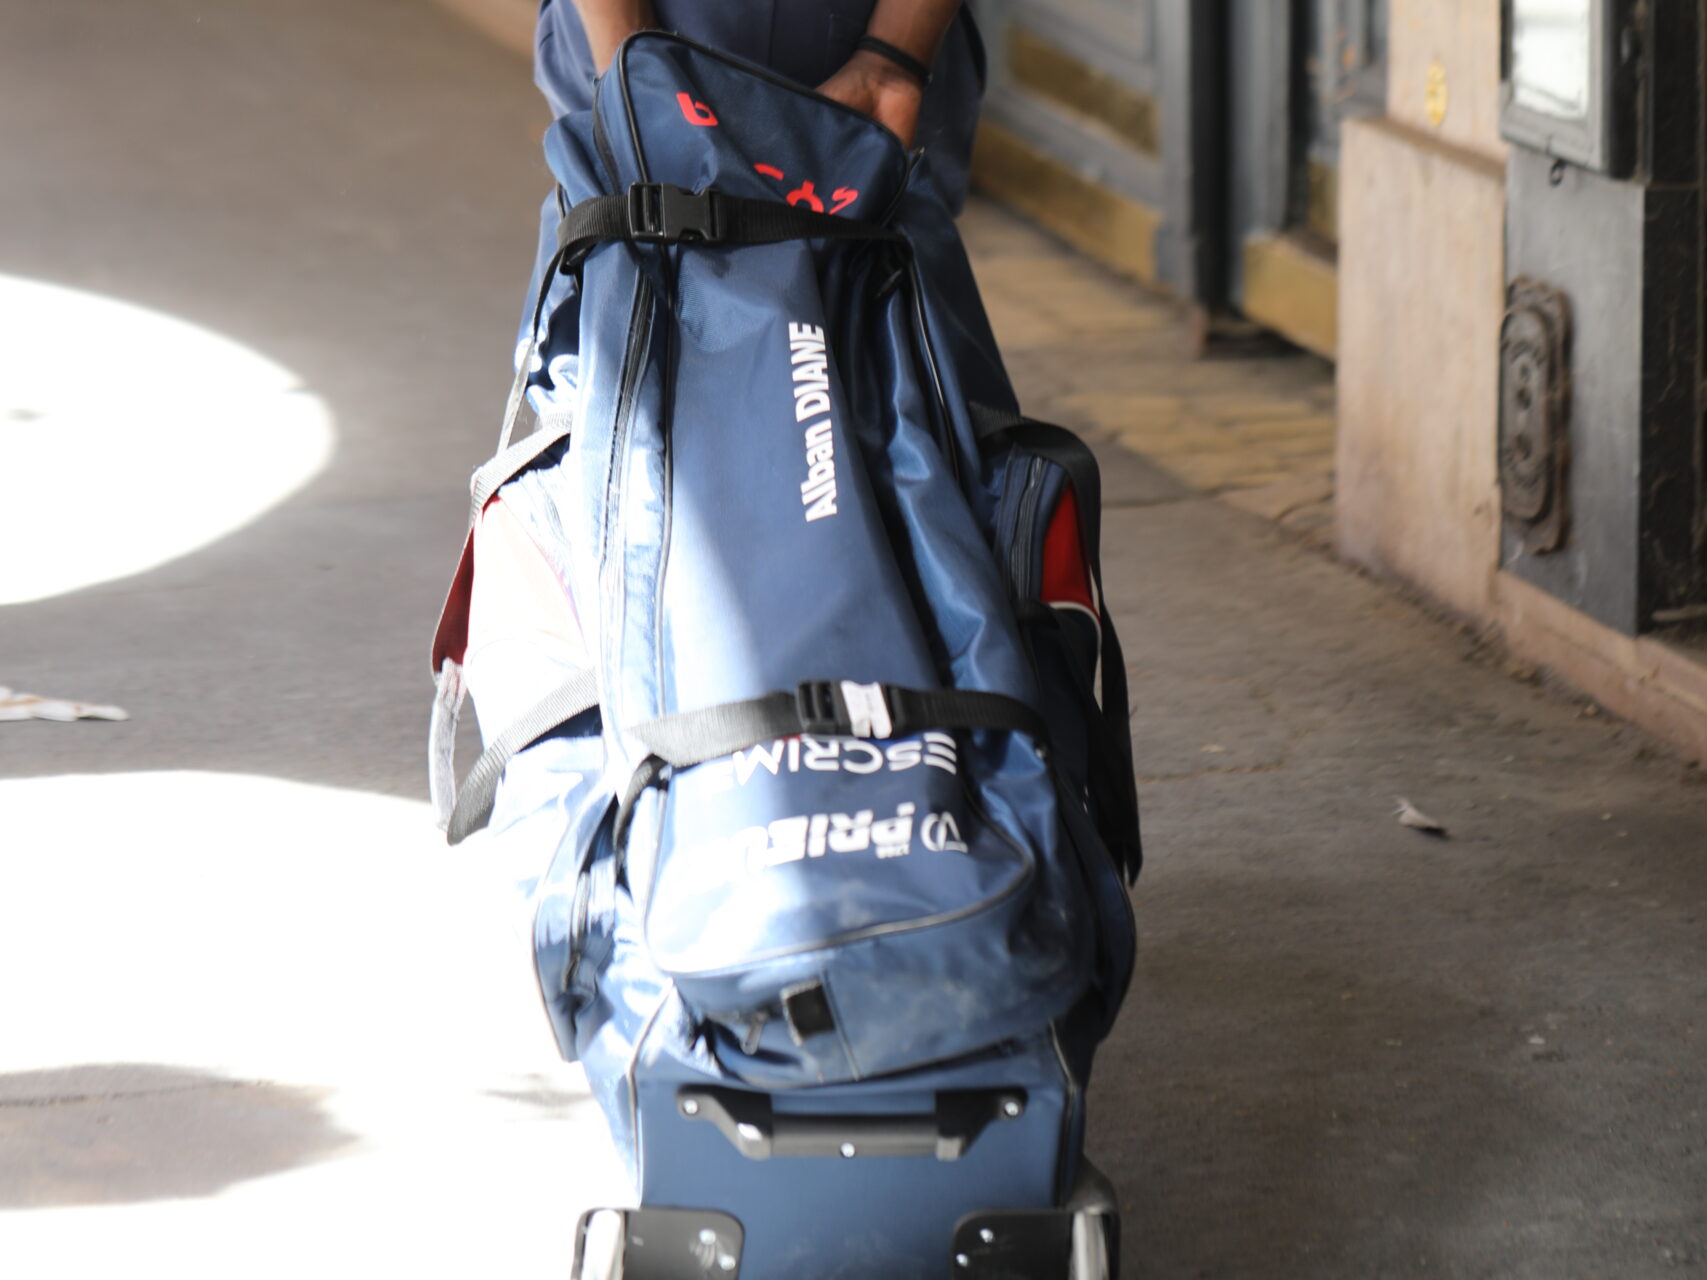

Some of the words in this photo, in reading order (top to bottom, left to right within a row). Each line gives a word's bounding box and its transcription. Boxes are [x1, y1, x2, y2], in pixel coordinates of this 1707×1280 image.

[789, 322, 830, 422] DIANE
[800, 419, 838, 522] Alban
[698, 802, 915, 872] PRIEU
